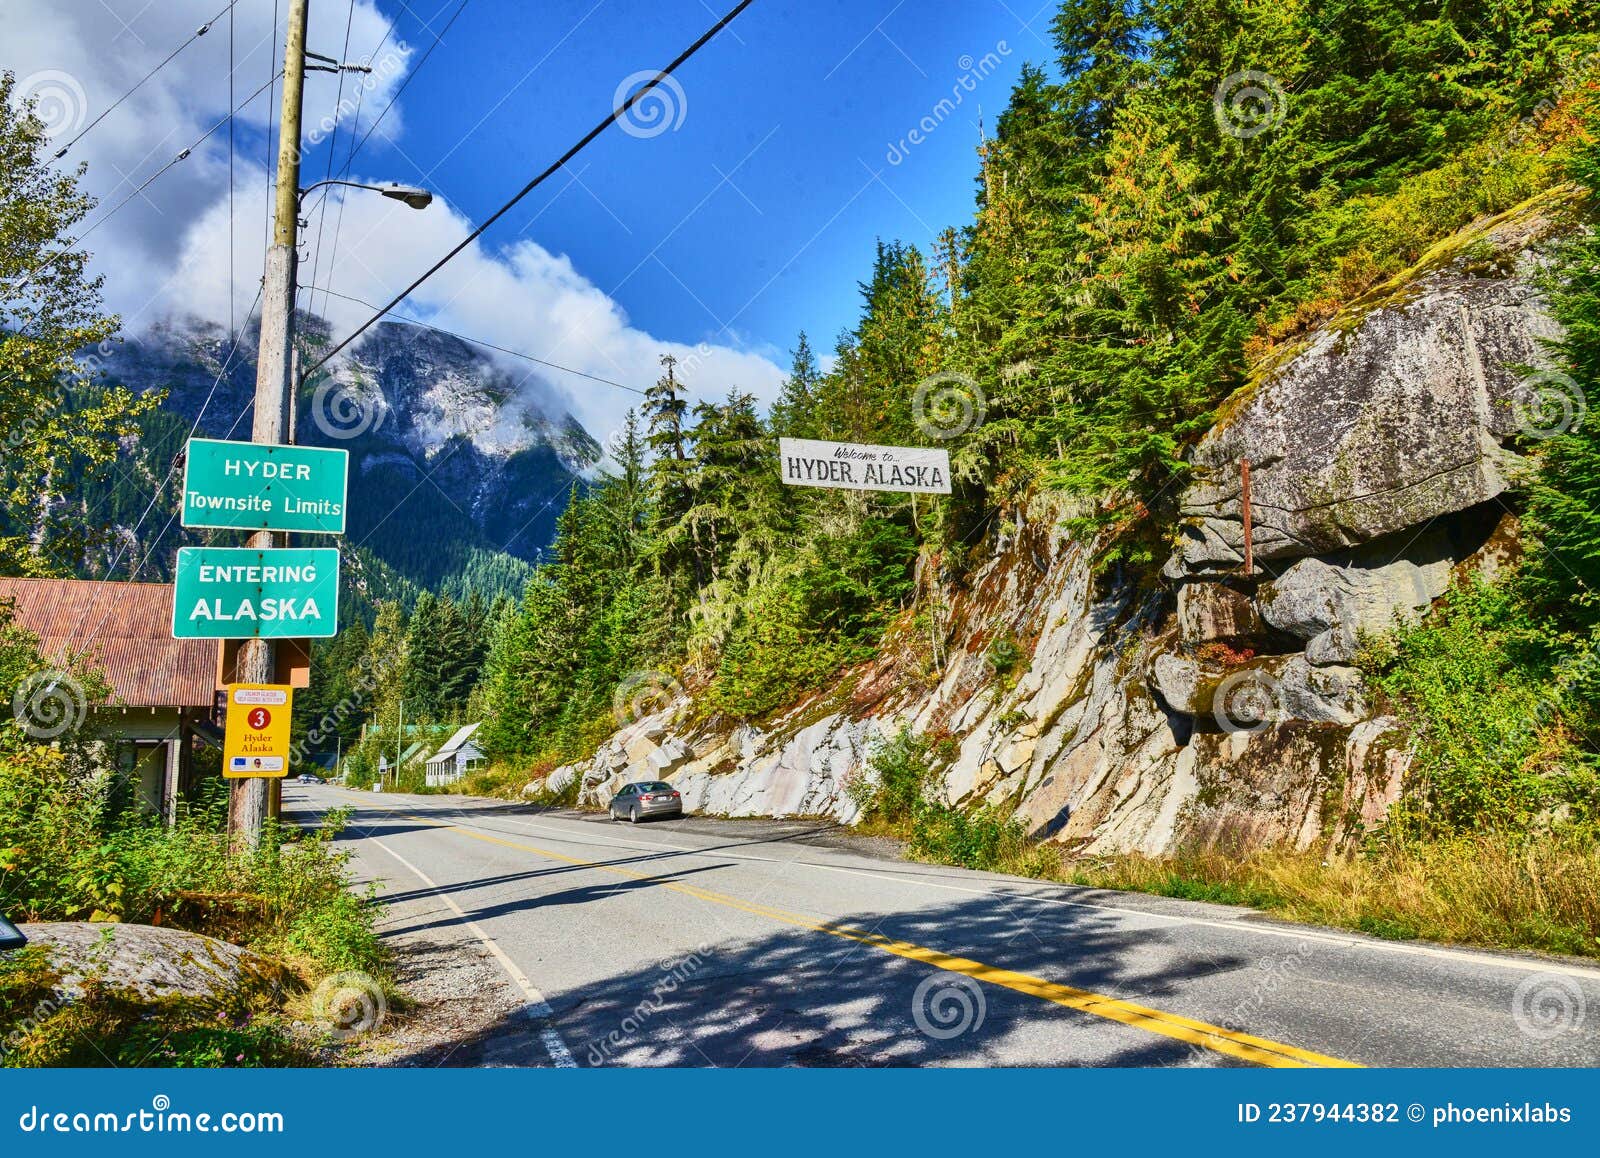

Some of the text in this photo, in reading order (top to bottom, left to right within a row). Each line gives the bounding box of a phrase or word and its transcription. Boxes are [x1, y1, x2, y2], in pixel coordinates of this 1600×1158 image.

[834, 447, 877, 461] Welcome
[225, 460, 311, 481] HYDER
[864, 464, 944, 488] ALASKA
[188, 491, 342, 516] Townsite Limits
[199, 565, 317, 583] ENTERING
[189, 598, 321, 621] ALASKA
[254, 711, 265, 727] 3
[241, 744, 273, 752] Alaska
[244, 734, 272, 744] Hyder
